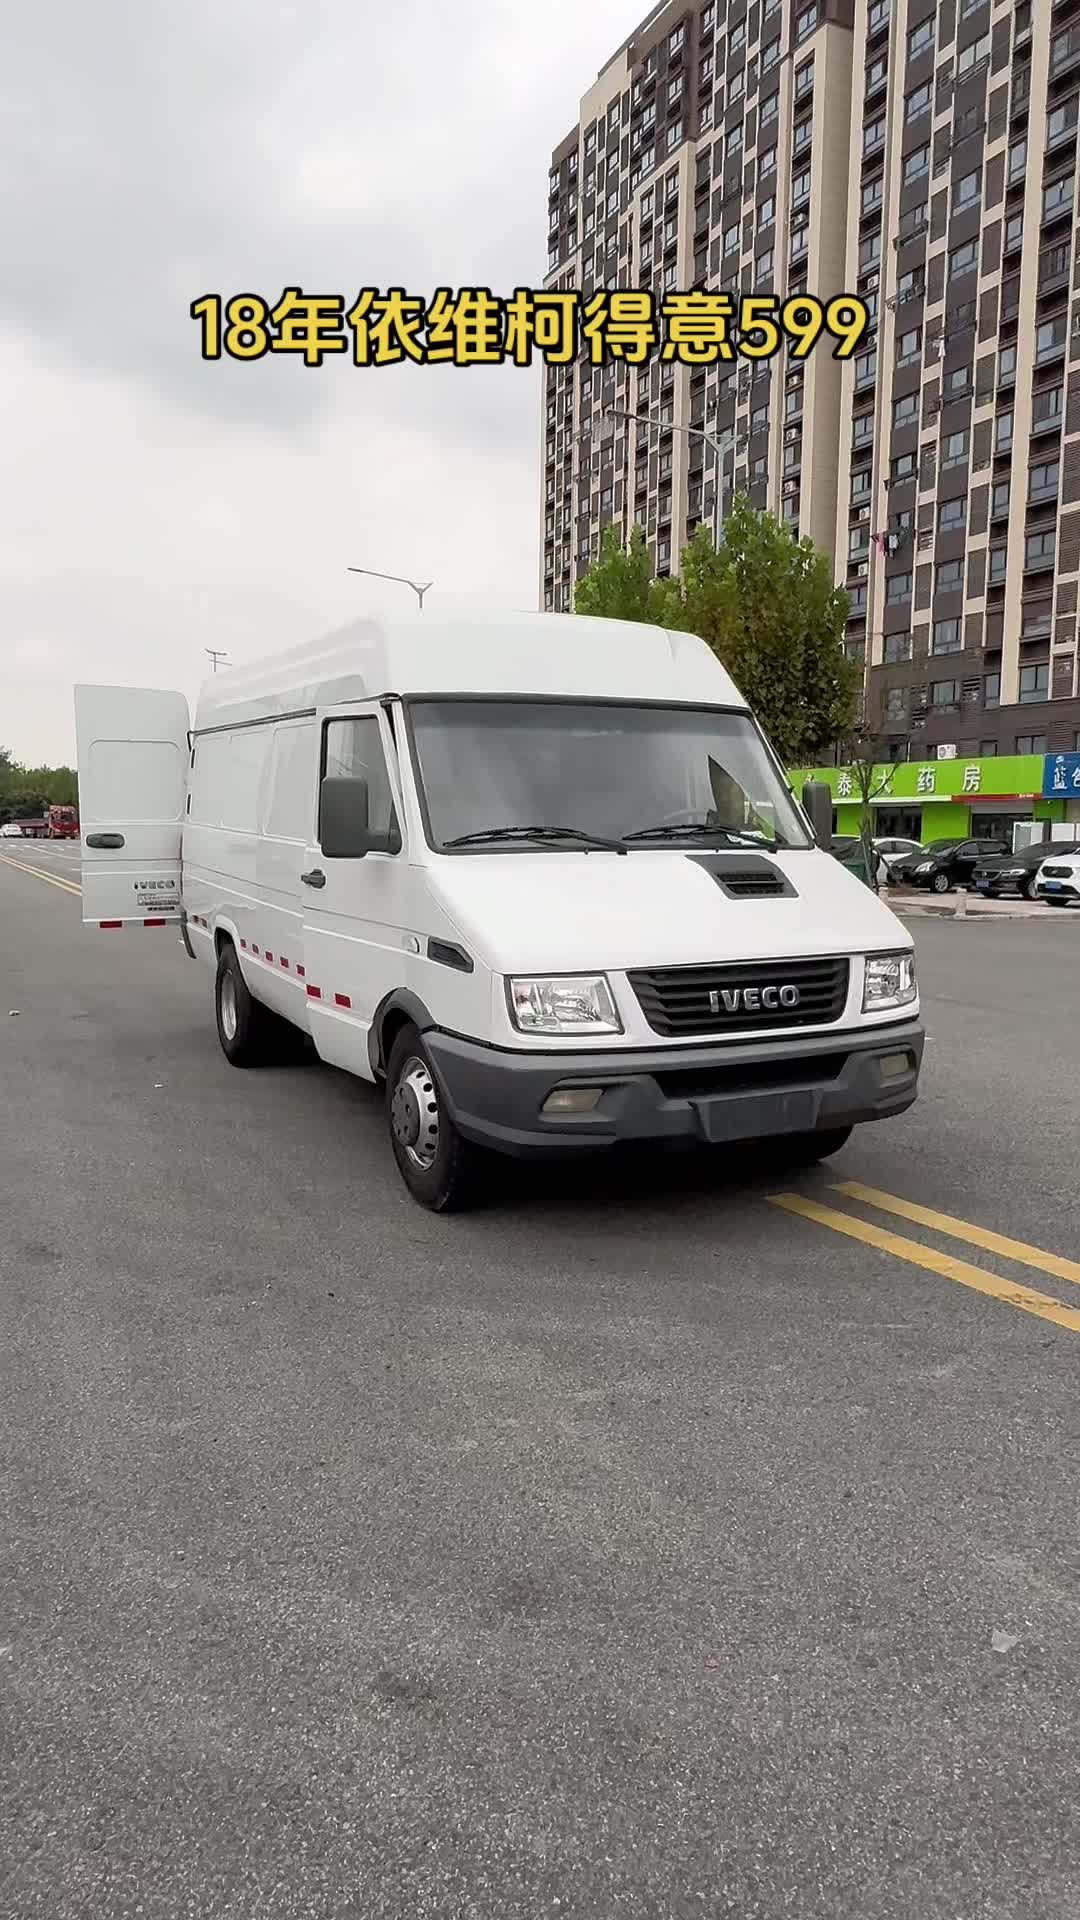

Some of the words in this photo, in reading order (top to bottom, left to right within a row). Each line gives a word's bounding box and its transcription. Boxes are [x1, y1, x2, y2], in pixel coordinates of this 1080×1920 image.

[804, 764, 981, 797] 泰大药房
[709, 985, 801, 1012] IVECO
